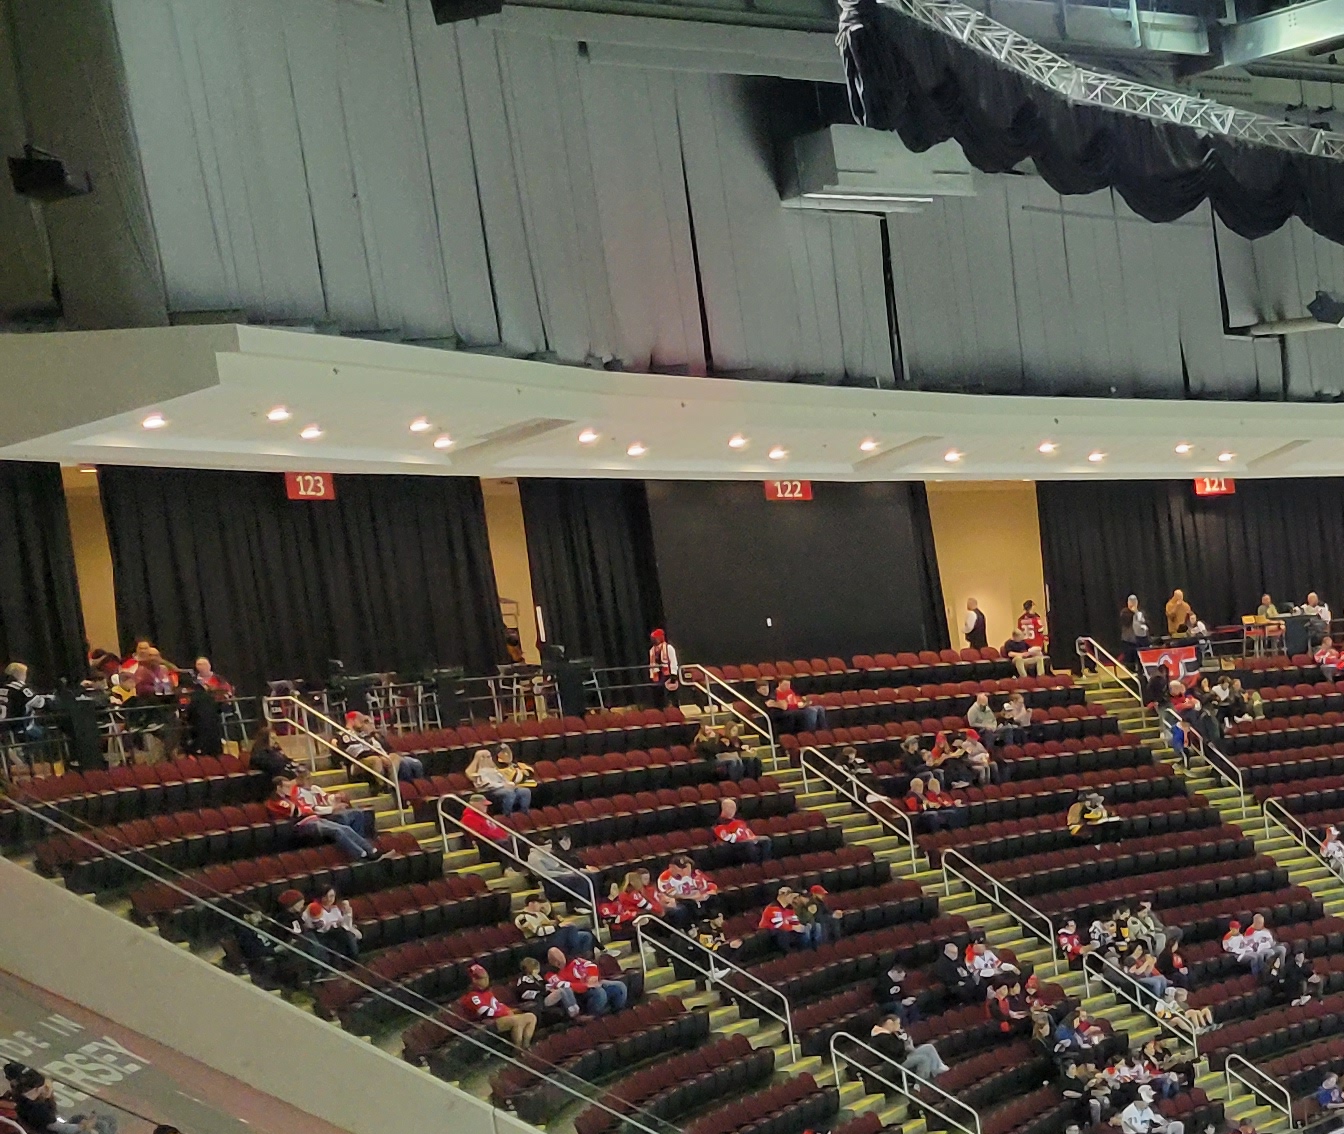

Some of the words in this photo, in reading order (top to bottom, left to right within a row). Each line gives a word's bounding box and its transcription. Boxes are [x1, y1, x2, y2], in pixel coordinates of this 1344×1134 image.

[296, 475, 324, 497] 123
[774, 481, 802, 499] 122
[1203, 477, 1227, 493] 121
[38, 1014, 85, 1037] IN
